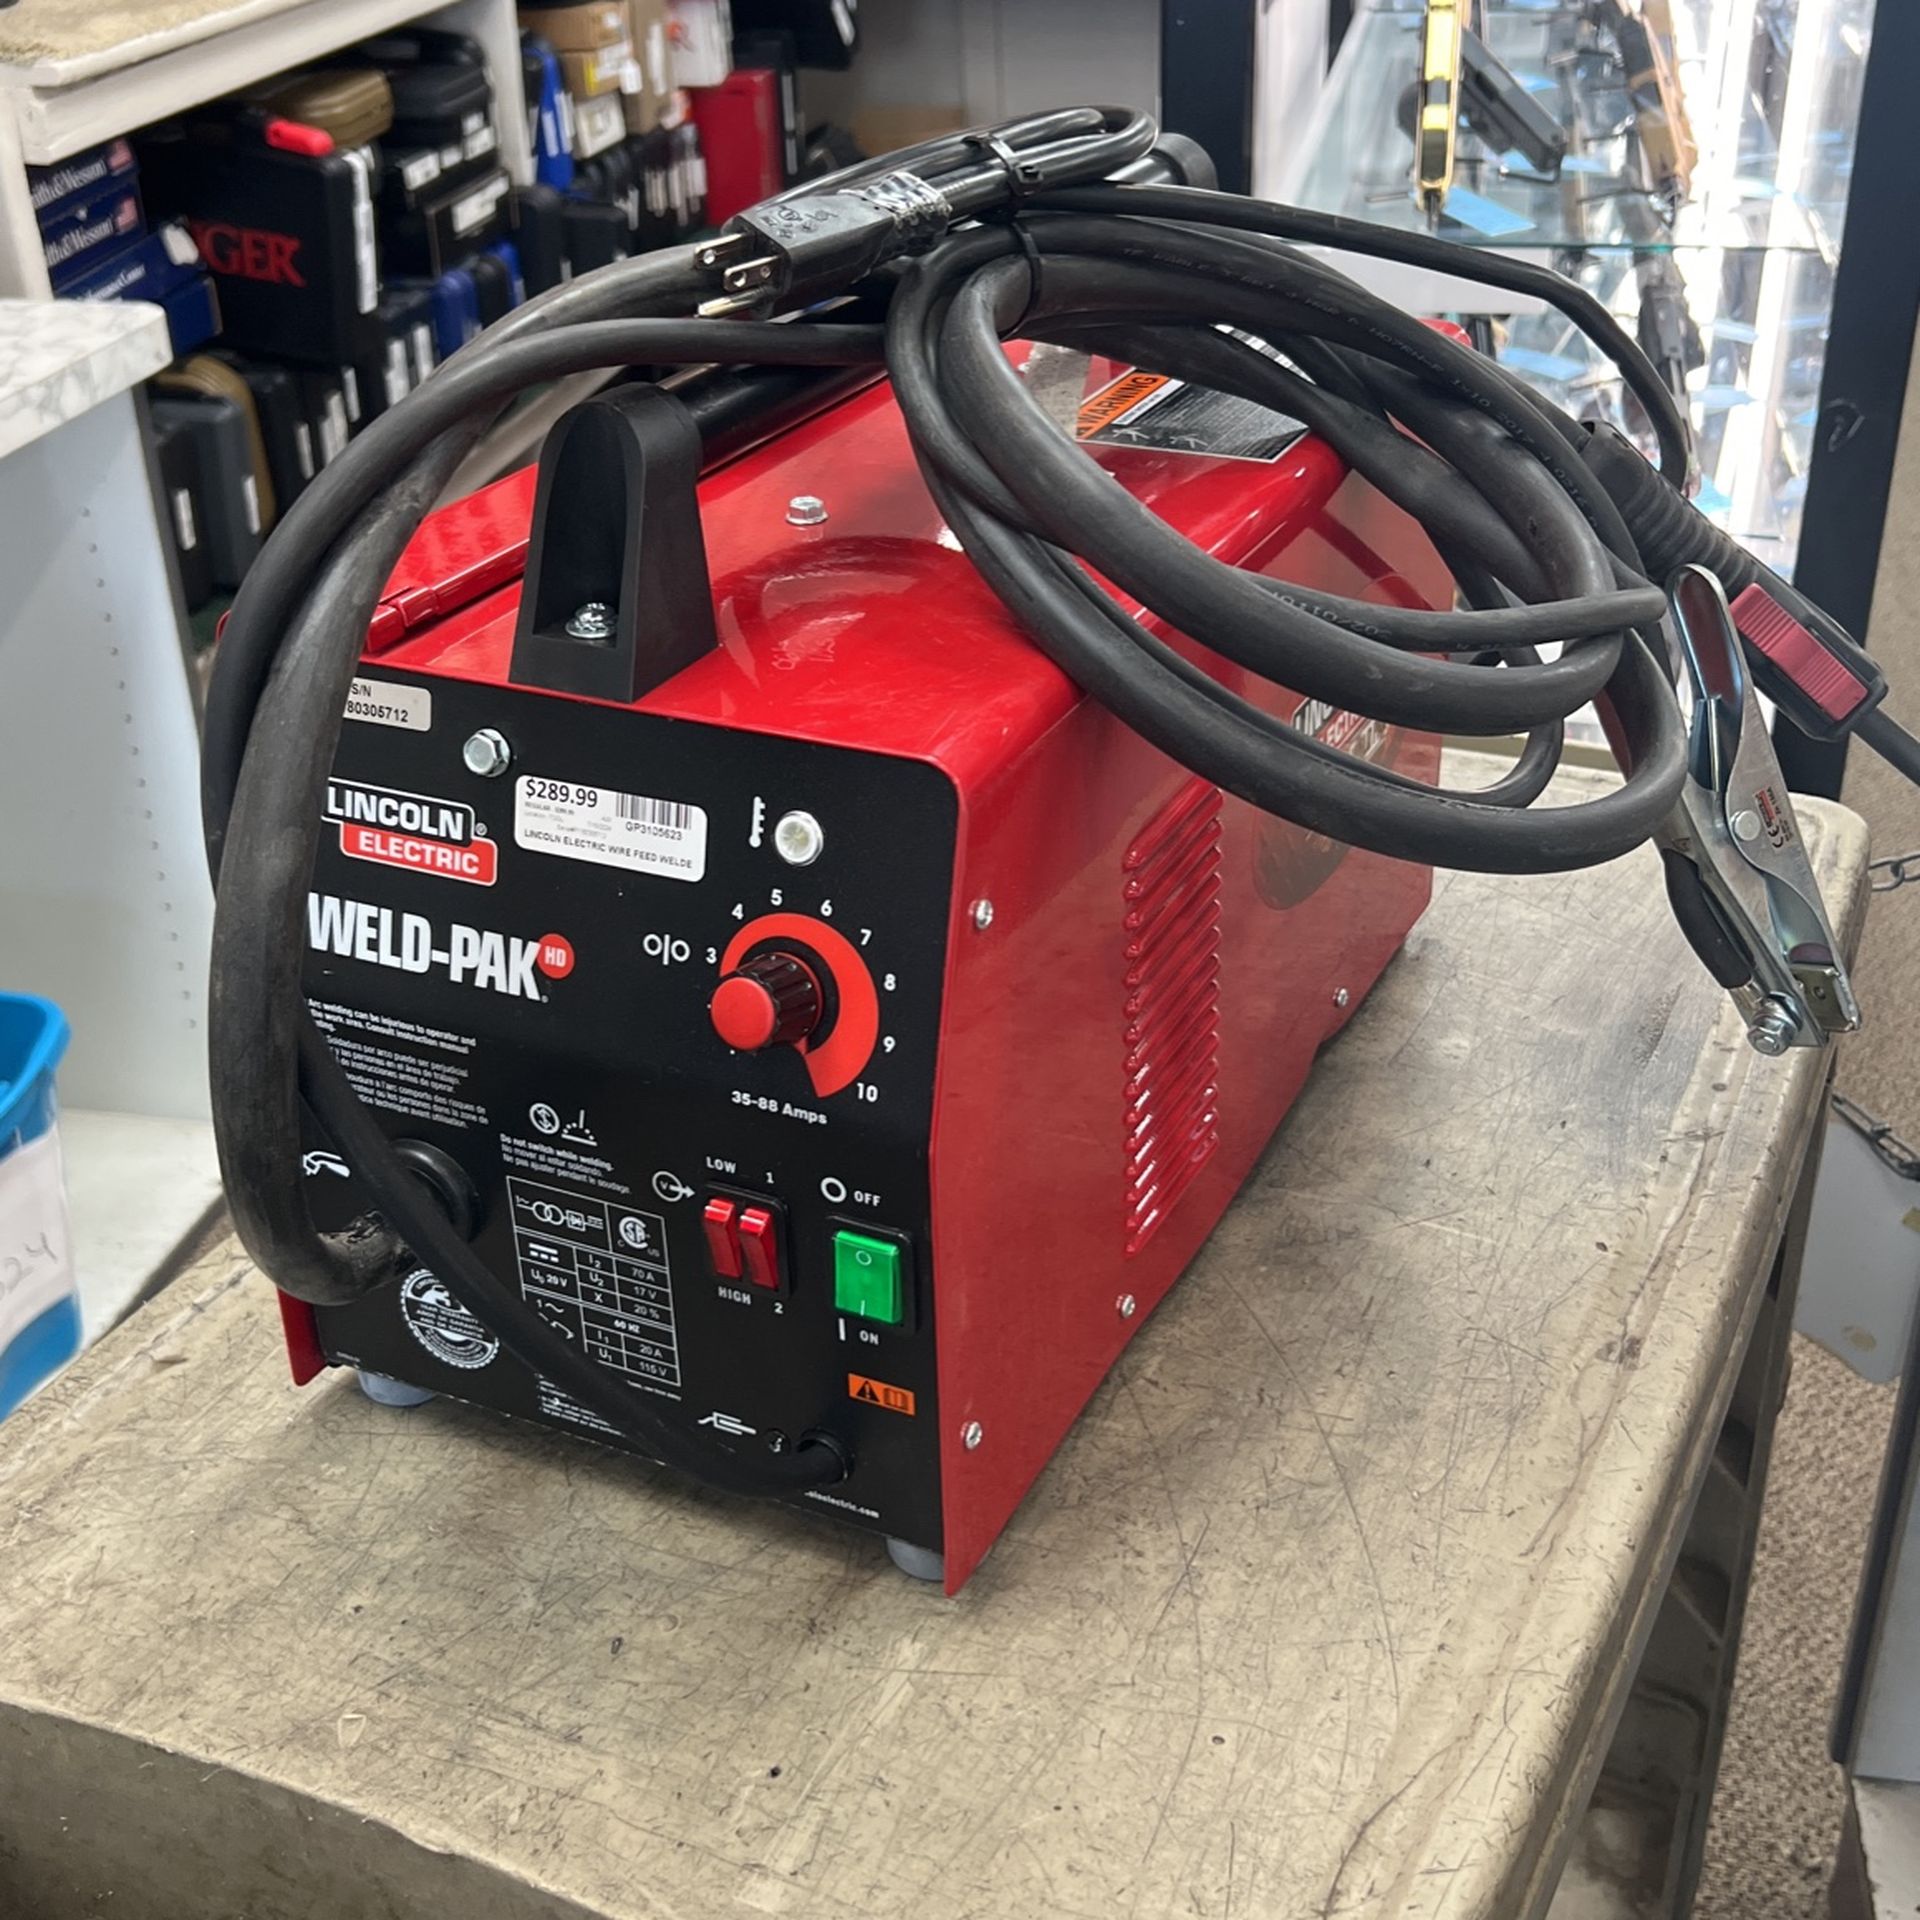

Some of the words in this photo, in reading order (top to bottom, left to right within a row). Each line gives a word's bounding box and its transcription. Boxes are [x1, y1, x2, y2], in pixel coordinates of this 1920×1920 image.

[1088, 375, 1159, 432] WARNING
[351, 684, 372, 697] S/N
[525, 778, 598, 808] $289.99
[328, 786, 464, 841] LINCOLN
[358, 831, 480, 875] ELECTRIC
[524, 828, 561, 843] LINCOLN
[563, 836, 606, 853] ELECTRIC
[608, 844, 631, 858] WIRE
[633, 848, 657, 863] FEED
[659, 854, 693, 869] WELDE
[770, 888, 783, 906] 5
[731, 903, 744, 920] 4
[820, 899, 833, 917] 6
[860, 928, 872, 946] 7
[308, 892, 542, 1001] WELD-PAK
[544, 945, 566, 967] HD
[705, 947, 718, 964] 3
[884, 973, 896, 991] 8
[323, 1004, 353, 1017] welding
[354, 1011, 369, 1019] can
[369, 1013, 379, 1022] be
[416, 1025, 424, 1033] to
[426, 1029, 458, 1041] operator
[882, 1036, 896, 1053] 9
[856, 1082, 878, 1102] 10
[731, 1090, 779, 1113] 35-88
[781, 1102, 828, 1125] Amps
[706, 1156, 737, 1174] LOW
[765, 1171, 775, 1184] 1
[853, 1190, 881, 1207] OFF
[631, 1267, 646, 1281] 70
[645, 1271, 656, 1282] A
[594, 1292, 604, 1304] X
[633, 1286, 648, 1298] 17
[648, 1289, 658, 1300] V
[718, 1286, 752, 1305] HIGH
[774, 1302, 784, 1315] 2
[859, 1330, 879, 1346] ON
